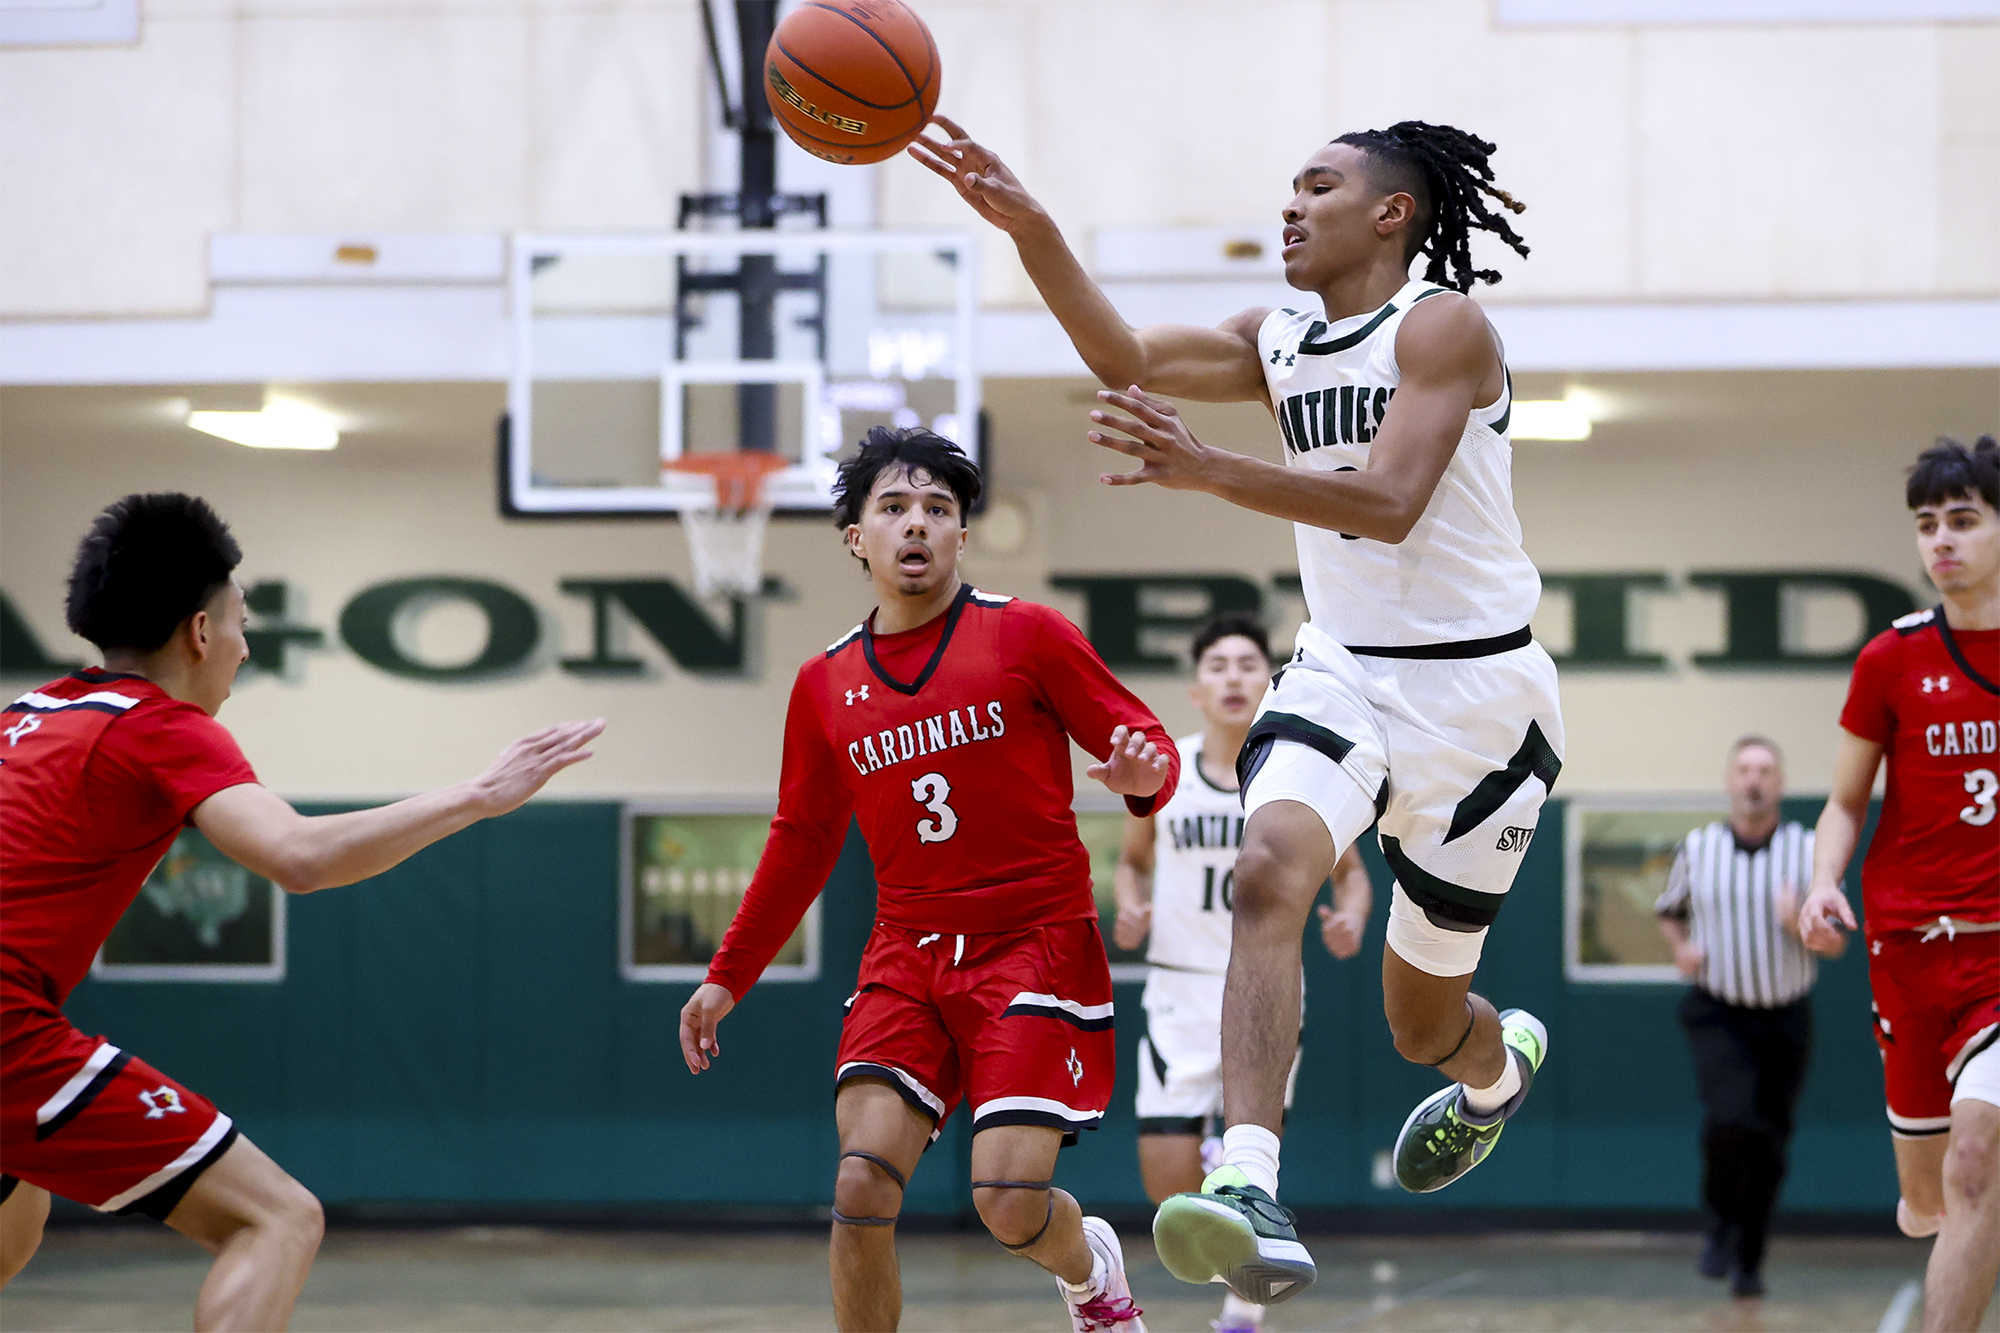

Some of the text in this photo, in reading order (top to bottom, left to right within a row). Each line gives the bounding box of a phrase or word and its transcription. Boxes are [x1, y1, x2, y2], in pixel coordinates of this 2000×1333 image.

[848, 700, 1005, 776] CARDINALS
[1926, 719, 2000, 757] CARD
[910, 771, 961, 847] 3
[1959, 768, 2000, 827] 3
[1496, 825, 1535, 853] SW
